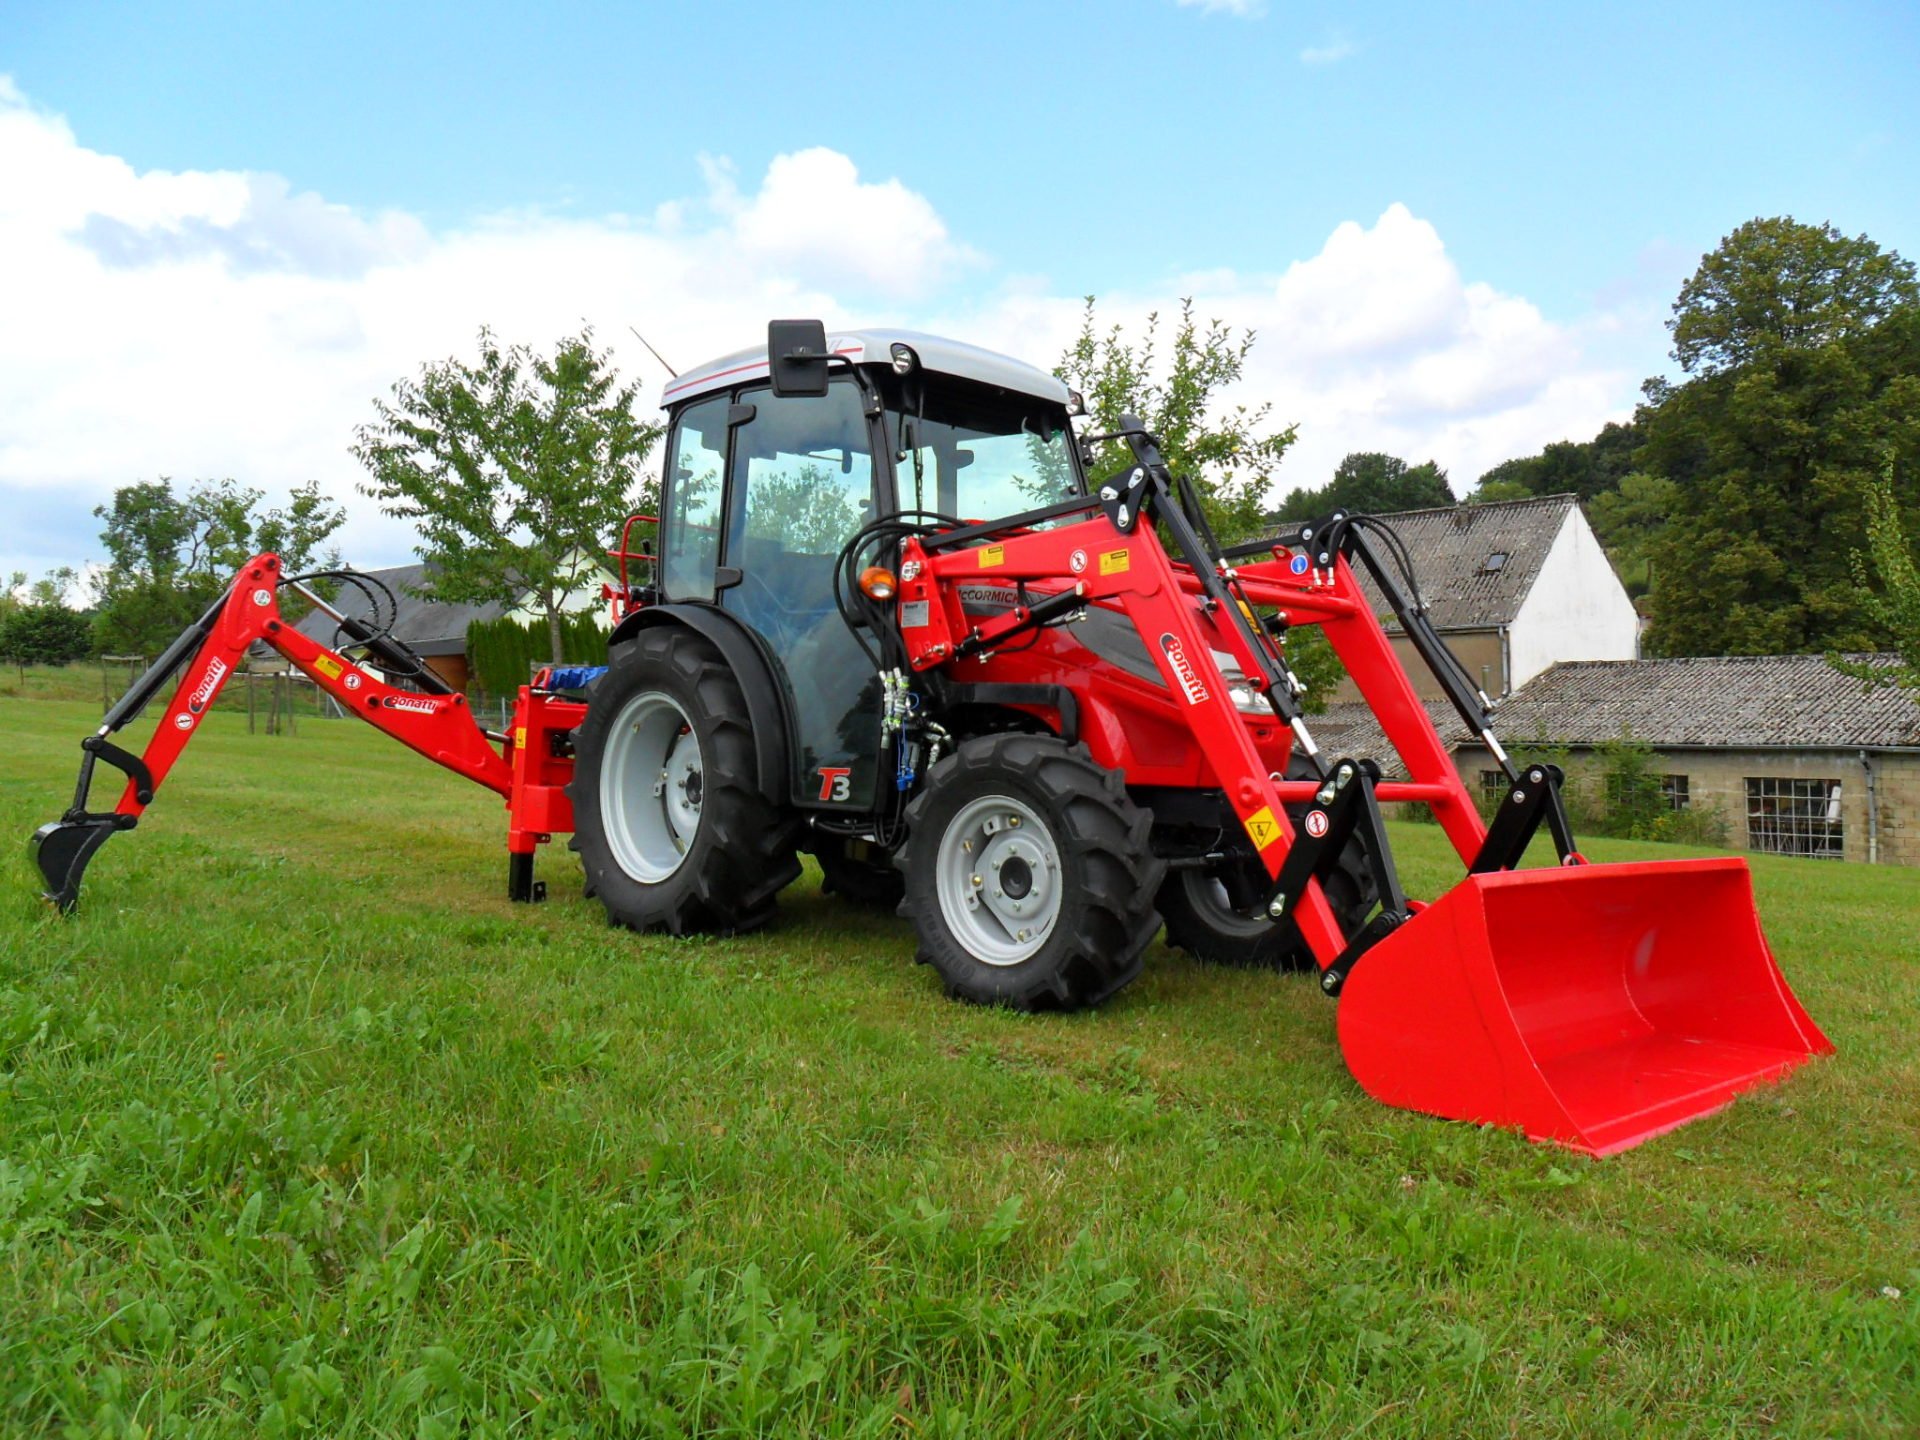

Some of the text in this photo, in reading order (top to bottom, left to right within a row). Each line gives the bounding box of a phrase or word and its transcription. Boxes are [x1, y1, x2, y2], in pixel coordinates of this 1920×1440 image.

[959, 589, 1019, 604] cCORMICK
[190, 656, 224, 707] Bonatti
[1166, 636, 1208, 702] Bonatti
[390, 696, 437, 711] Bonatti
[817, 767, 851, 801] T3
